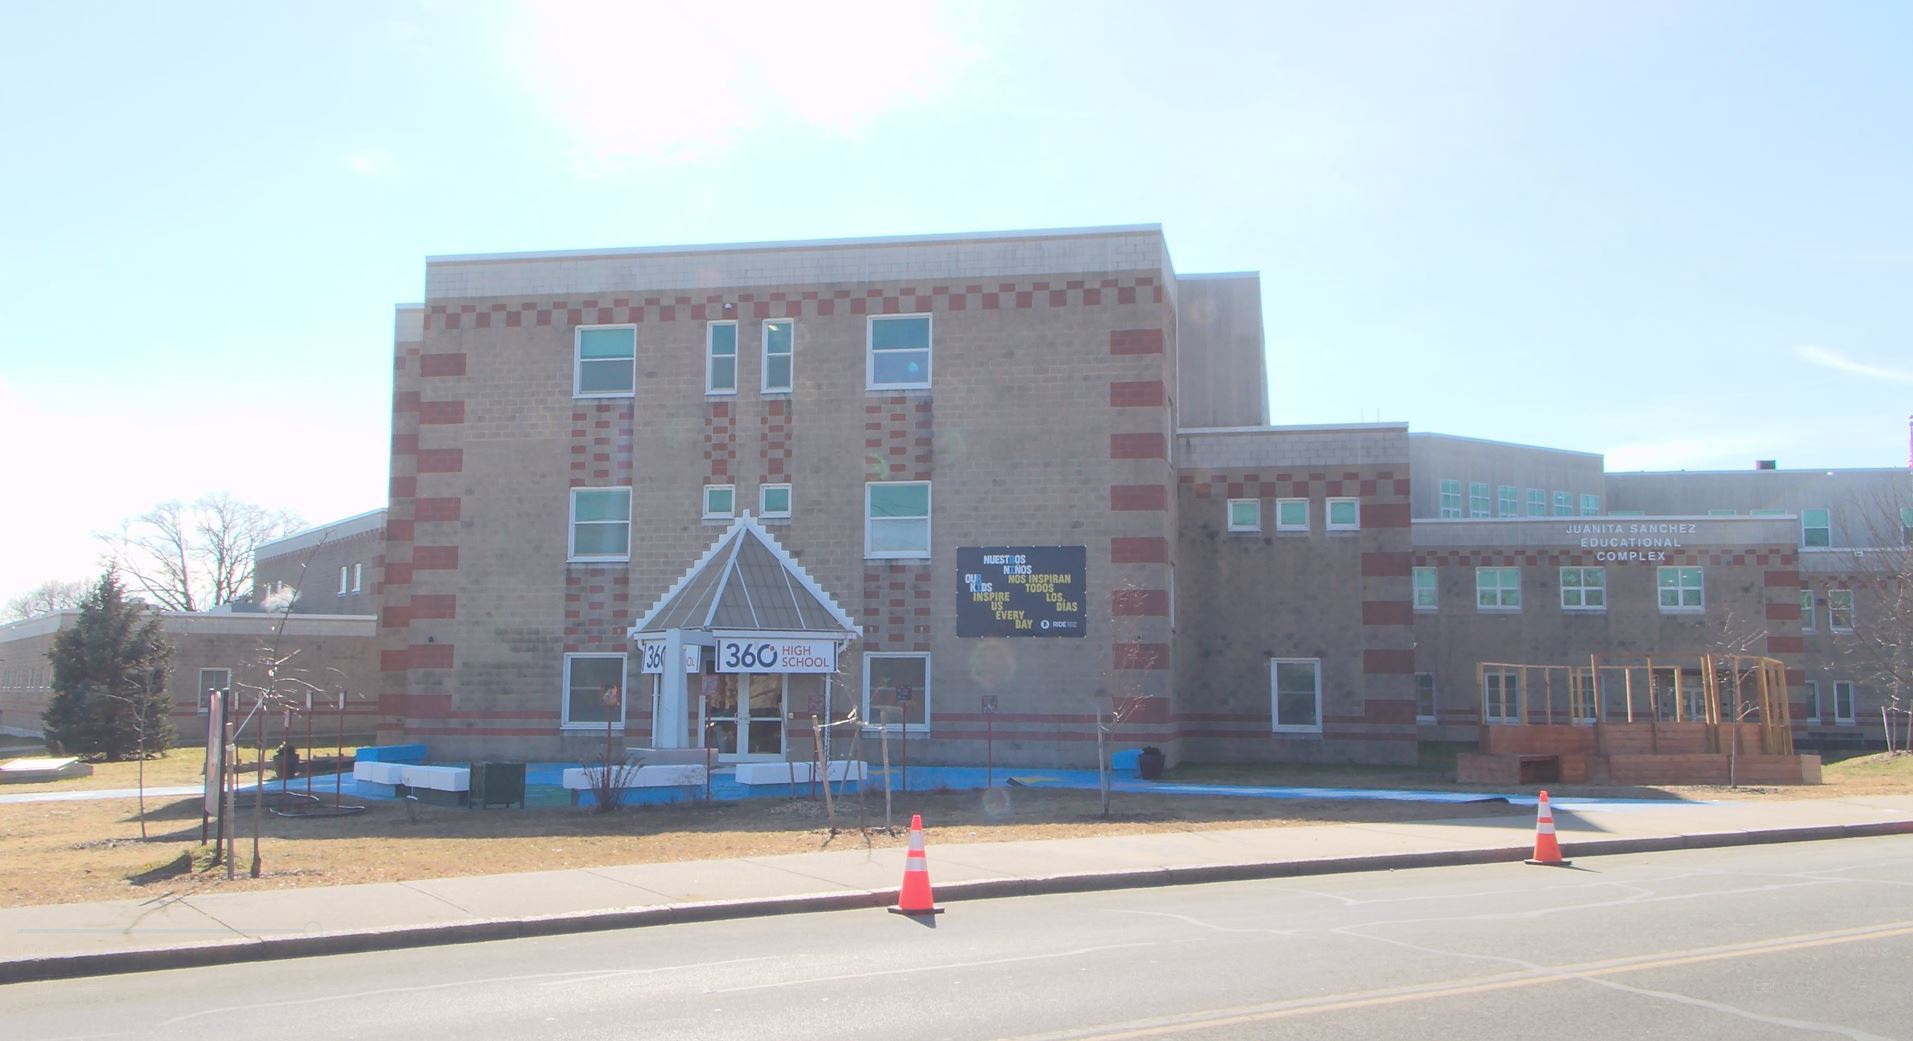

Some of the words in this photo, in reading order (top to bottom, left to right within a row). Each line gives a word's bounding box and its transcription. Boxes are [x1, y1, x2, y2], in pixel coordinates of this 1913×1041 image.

[1566, 524, 1624, 534] JUANITA
[1630, 524, 1696, 534] SANCHEZ
[1580, 538, 1681, 548] EDUCATIONAL
[983, 555, 1026, 565] NUESTROS
[1596, 551, 1666, 561] COMPLEX
[964, 574, 982, 583] OUR
[1008, 574, 1026, 583] NOS
[1028, 574, 1071, 583] INSPIRAN
[970, 582, 993, 592] KIDS
[1025, 583, 1054, 592] TODOS
[973, 592, 1010, 601] INSPIRE
[1046, 592, 1063, 602] LOS
[991, 601, 1003, 611] US
[995, 610, 1025, 620] EVERY
[1015, 619, 1033, 629] DAY
[782, 645, 811, 656] HIGH
[781, 656, 829, 667] SCHOOL
